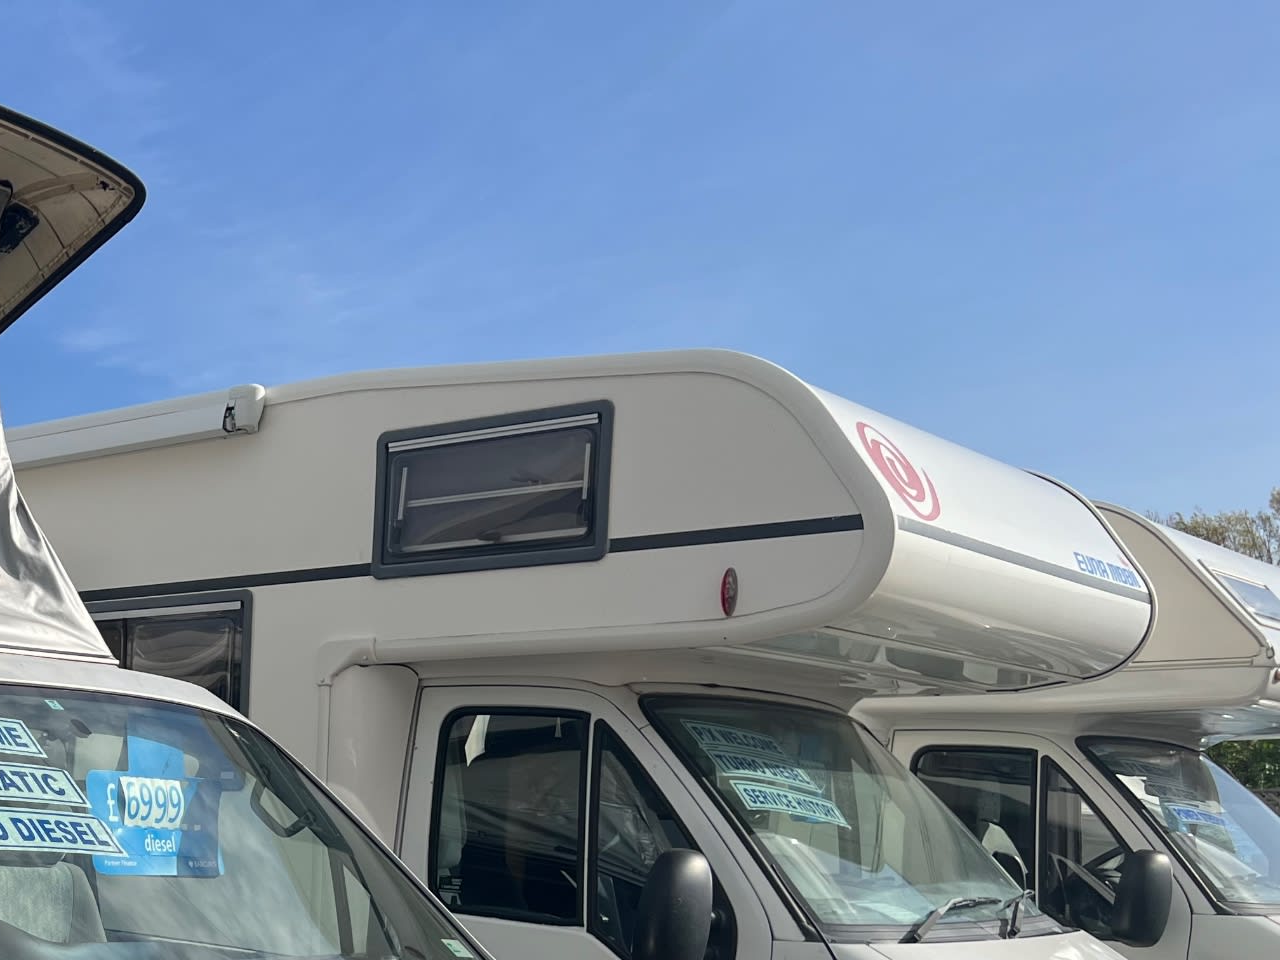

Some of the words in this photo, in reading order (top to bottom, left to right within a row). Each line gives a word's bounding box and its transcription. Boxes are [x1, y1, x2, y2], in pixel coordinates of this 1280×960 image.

[713, 754, 767, 775] TURBO
[762, 760, 811, 785] DIESEL
[743, 788, 798, 809] SERVICE
[791, 797, 840, 820] HISTORY
[9, 817, 111, 846] DIESEL
[144, 834, 176, 852] diesel
